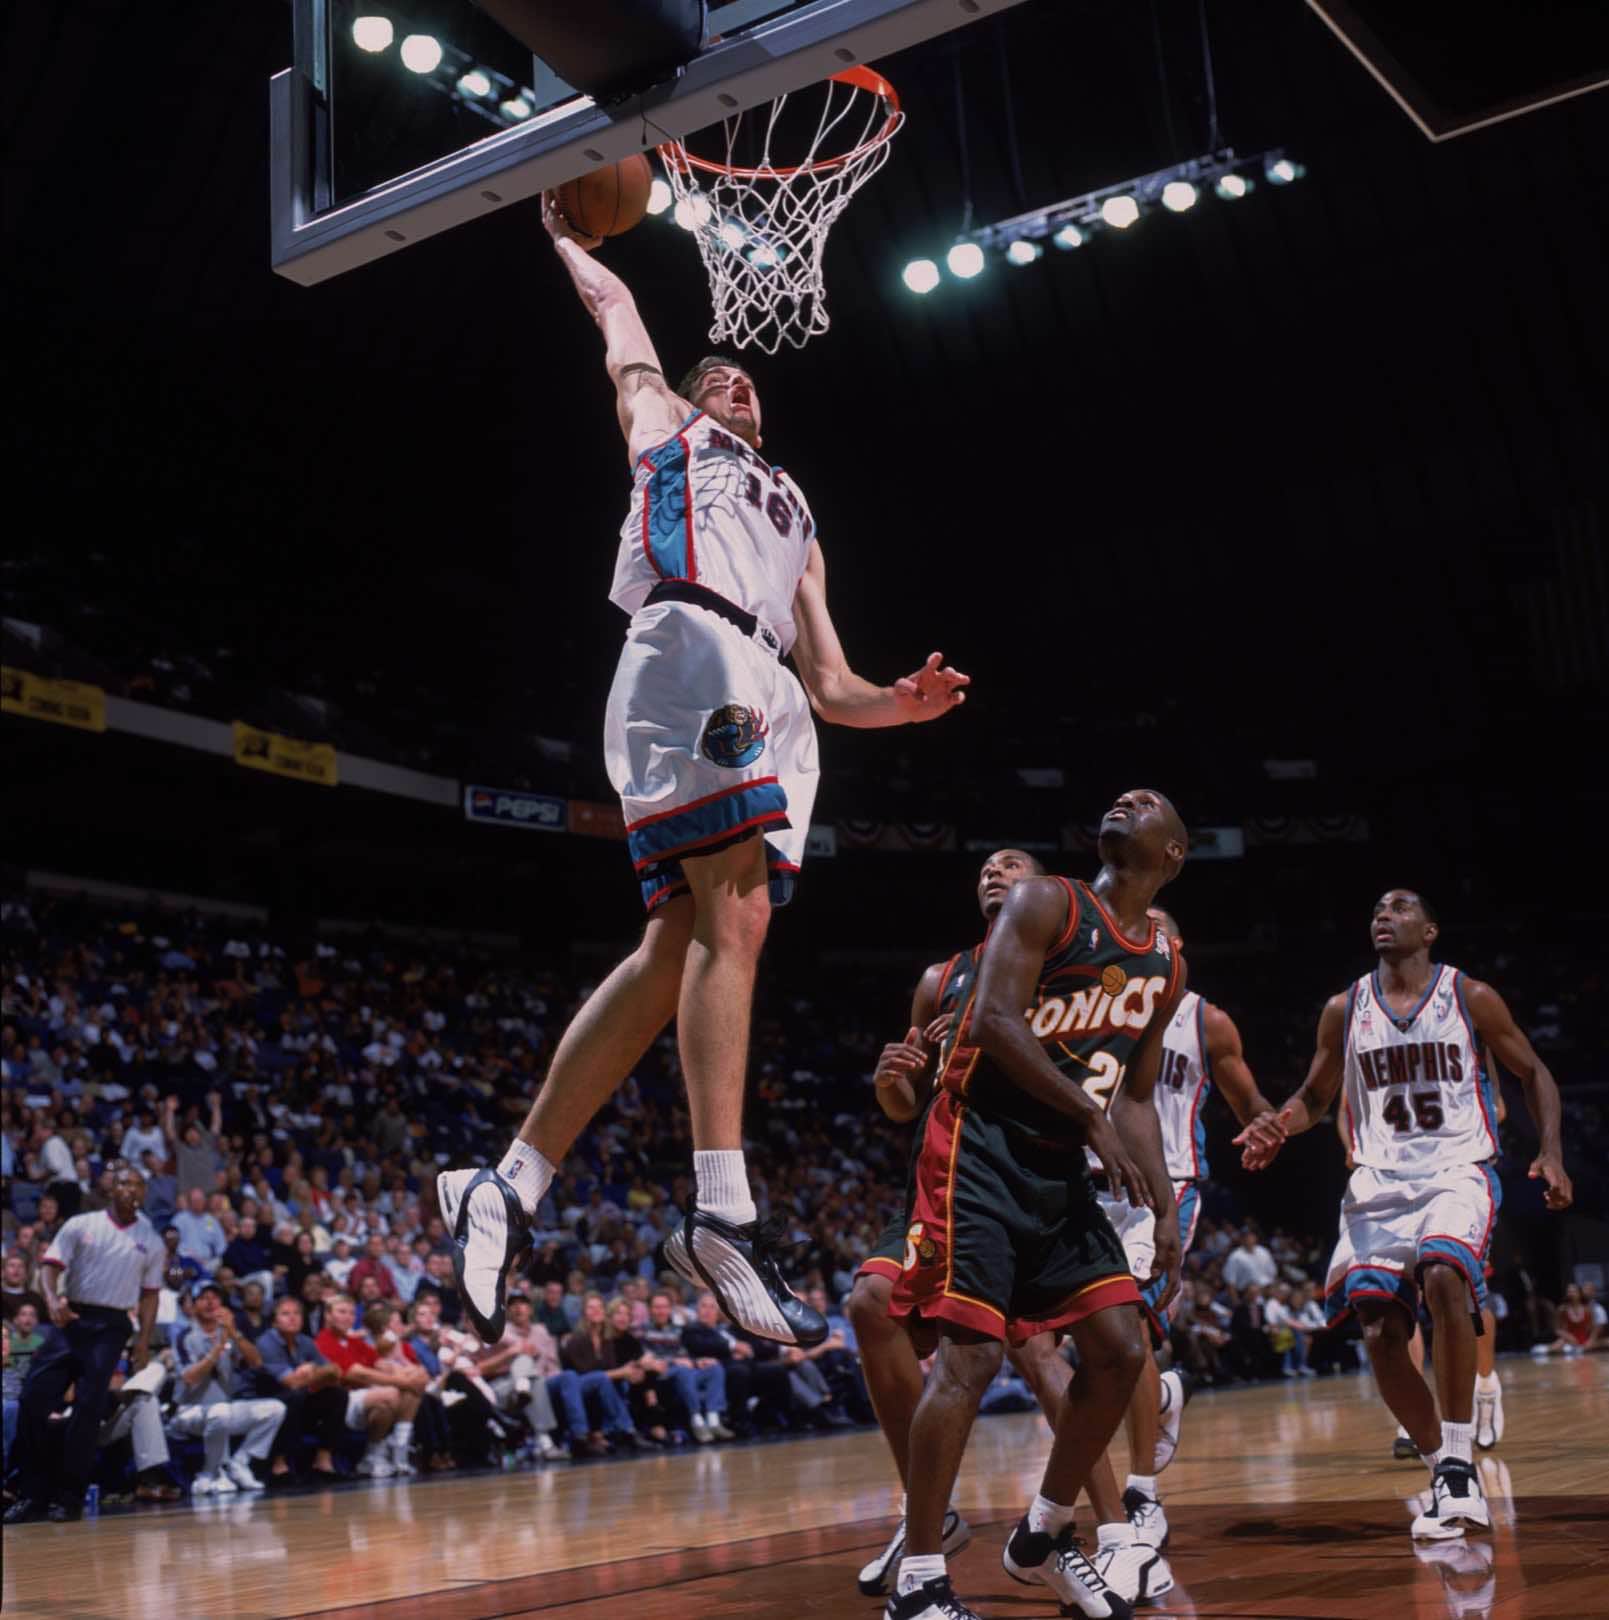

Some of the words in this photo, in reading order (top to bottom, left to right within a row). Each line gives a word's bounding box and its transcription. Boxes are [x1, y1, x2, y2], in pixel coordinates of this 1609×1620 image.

[496, 796, 560, 821] PEPSI
[1024, 973, 1166, 1038] ONICS
[1358, 1041, 1464, 1092] MEMPHIS
[1382, 1091, 1445, 1133] 45
